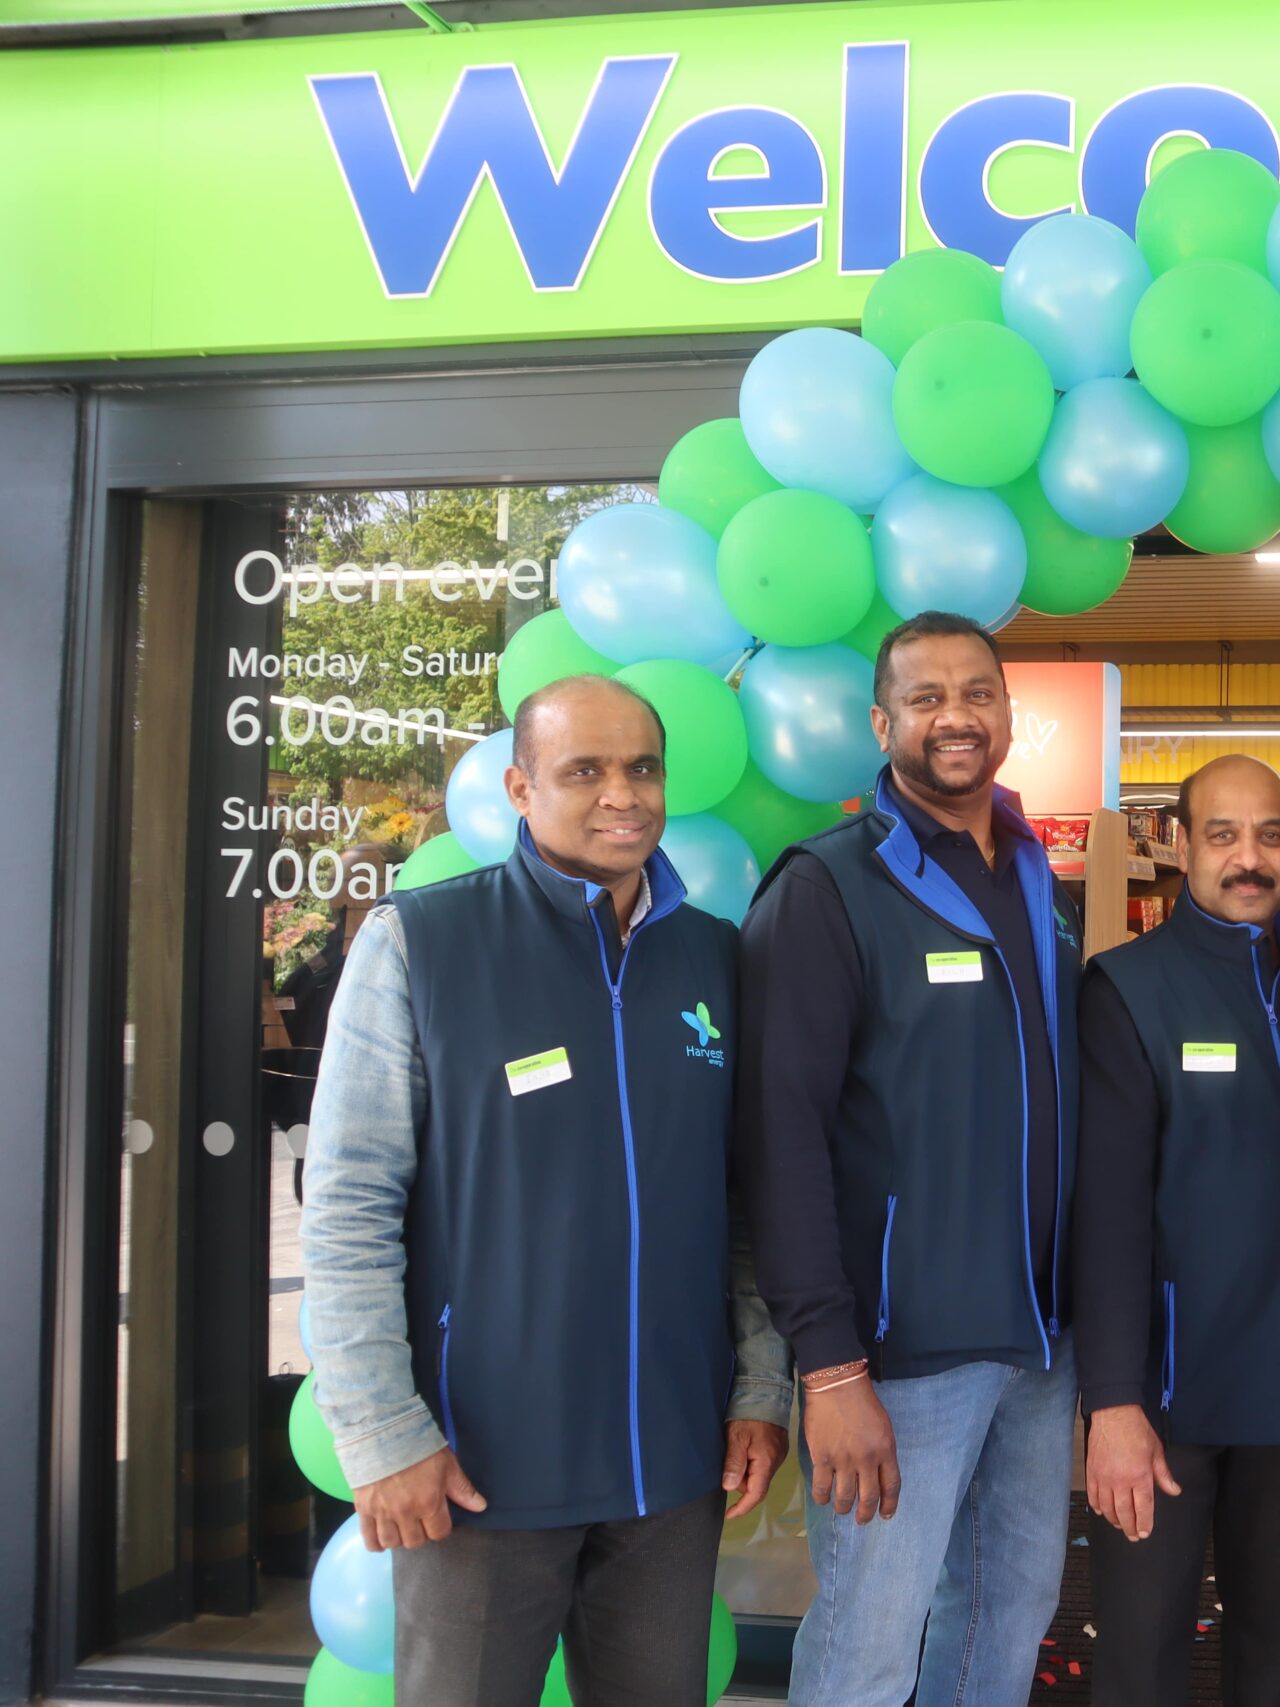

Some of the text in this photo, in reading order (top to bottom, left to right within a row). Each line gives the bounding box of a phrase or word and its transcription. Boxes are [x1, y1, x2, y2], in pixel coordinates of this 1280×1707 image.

[234, 549, 405, 618] Open
[227, 646, 367, 685] Monday
[401, 645, 504, 678] Satur
[226, 694, 446, 746] 6.00am
[221, 797, 364, 839] Sunday
[686, 1045, 724, 1060] Harvest
